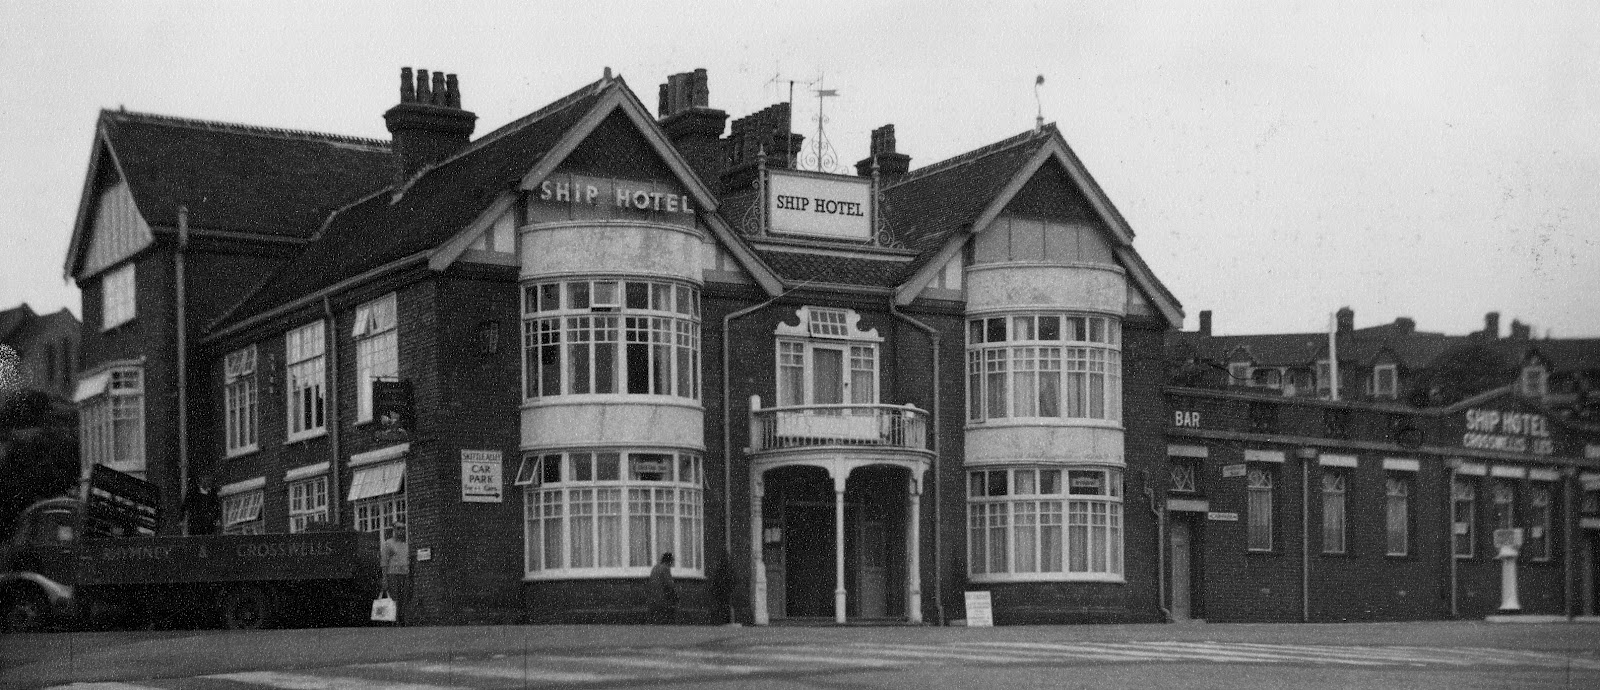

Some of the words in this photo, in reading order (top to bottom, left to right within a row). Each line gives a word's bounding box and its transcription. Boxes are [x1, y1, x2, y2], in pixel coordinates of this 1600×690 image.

[541, 180, 599, 204] SHIP
[616, 188, 694, 214] HOTEL
[776, 194, 810, 211] SHIP
[814, 198, 864, 217] HOTEL
[1175, 410, 1200, 428] BAR
[1466, 408, 1499, 432] SHIP
[1502, 412, 1550, 438] HOTEL
[471, 464, 491, 474] CAR
[469, 474, 494, 484] PARK
[197, 544, 208, 558] &
[236, 541, 333, 558] CROSSWELLS
